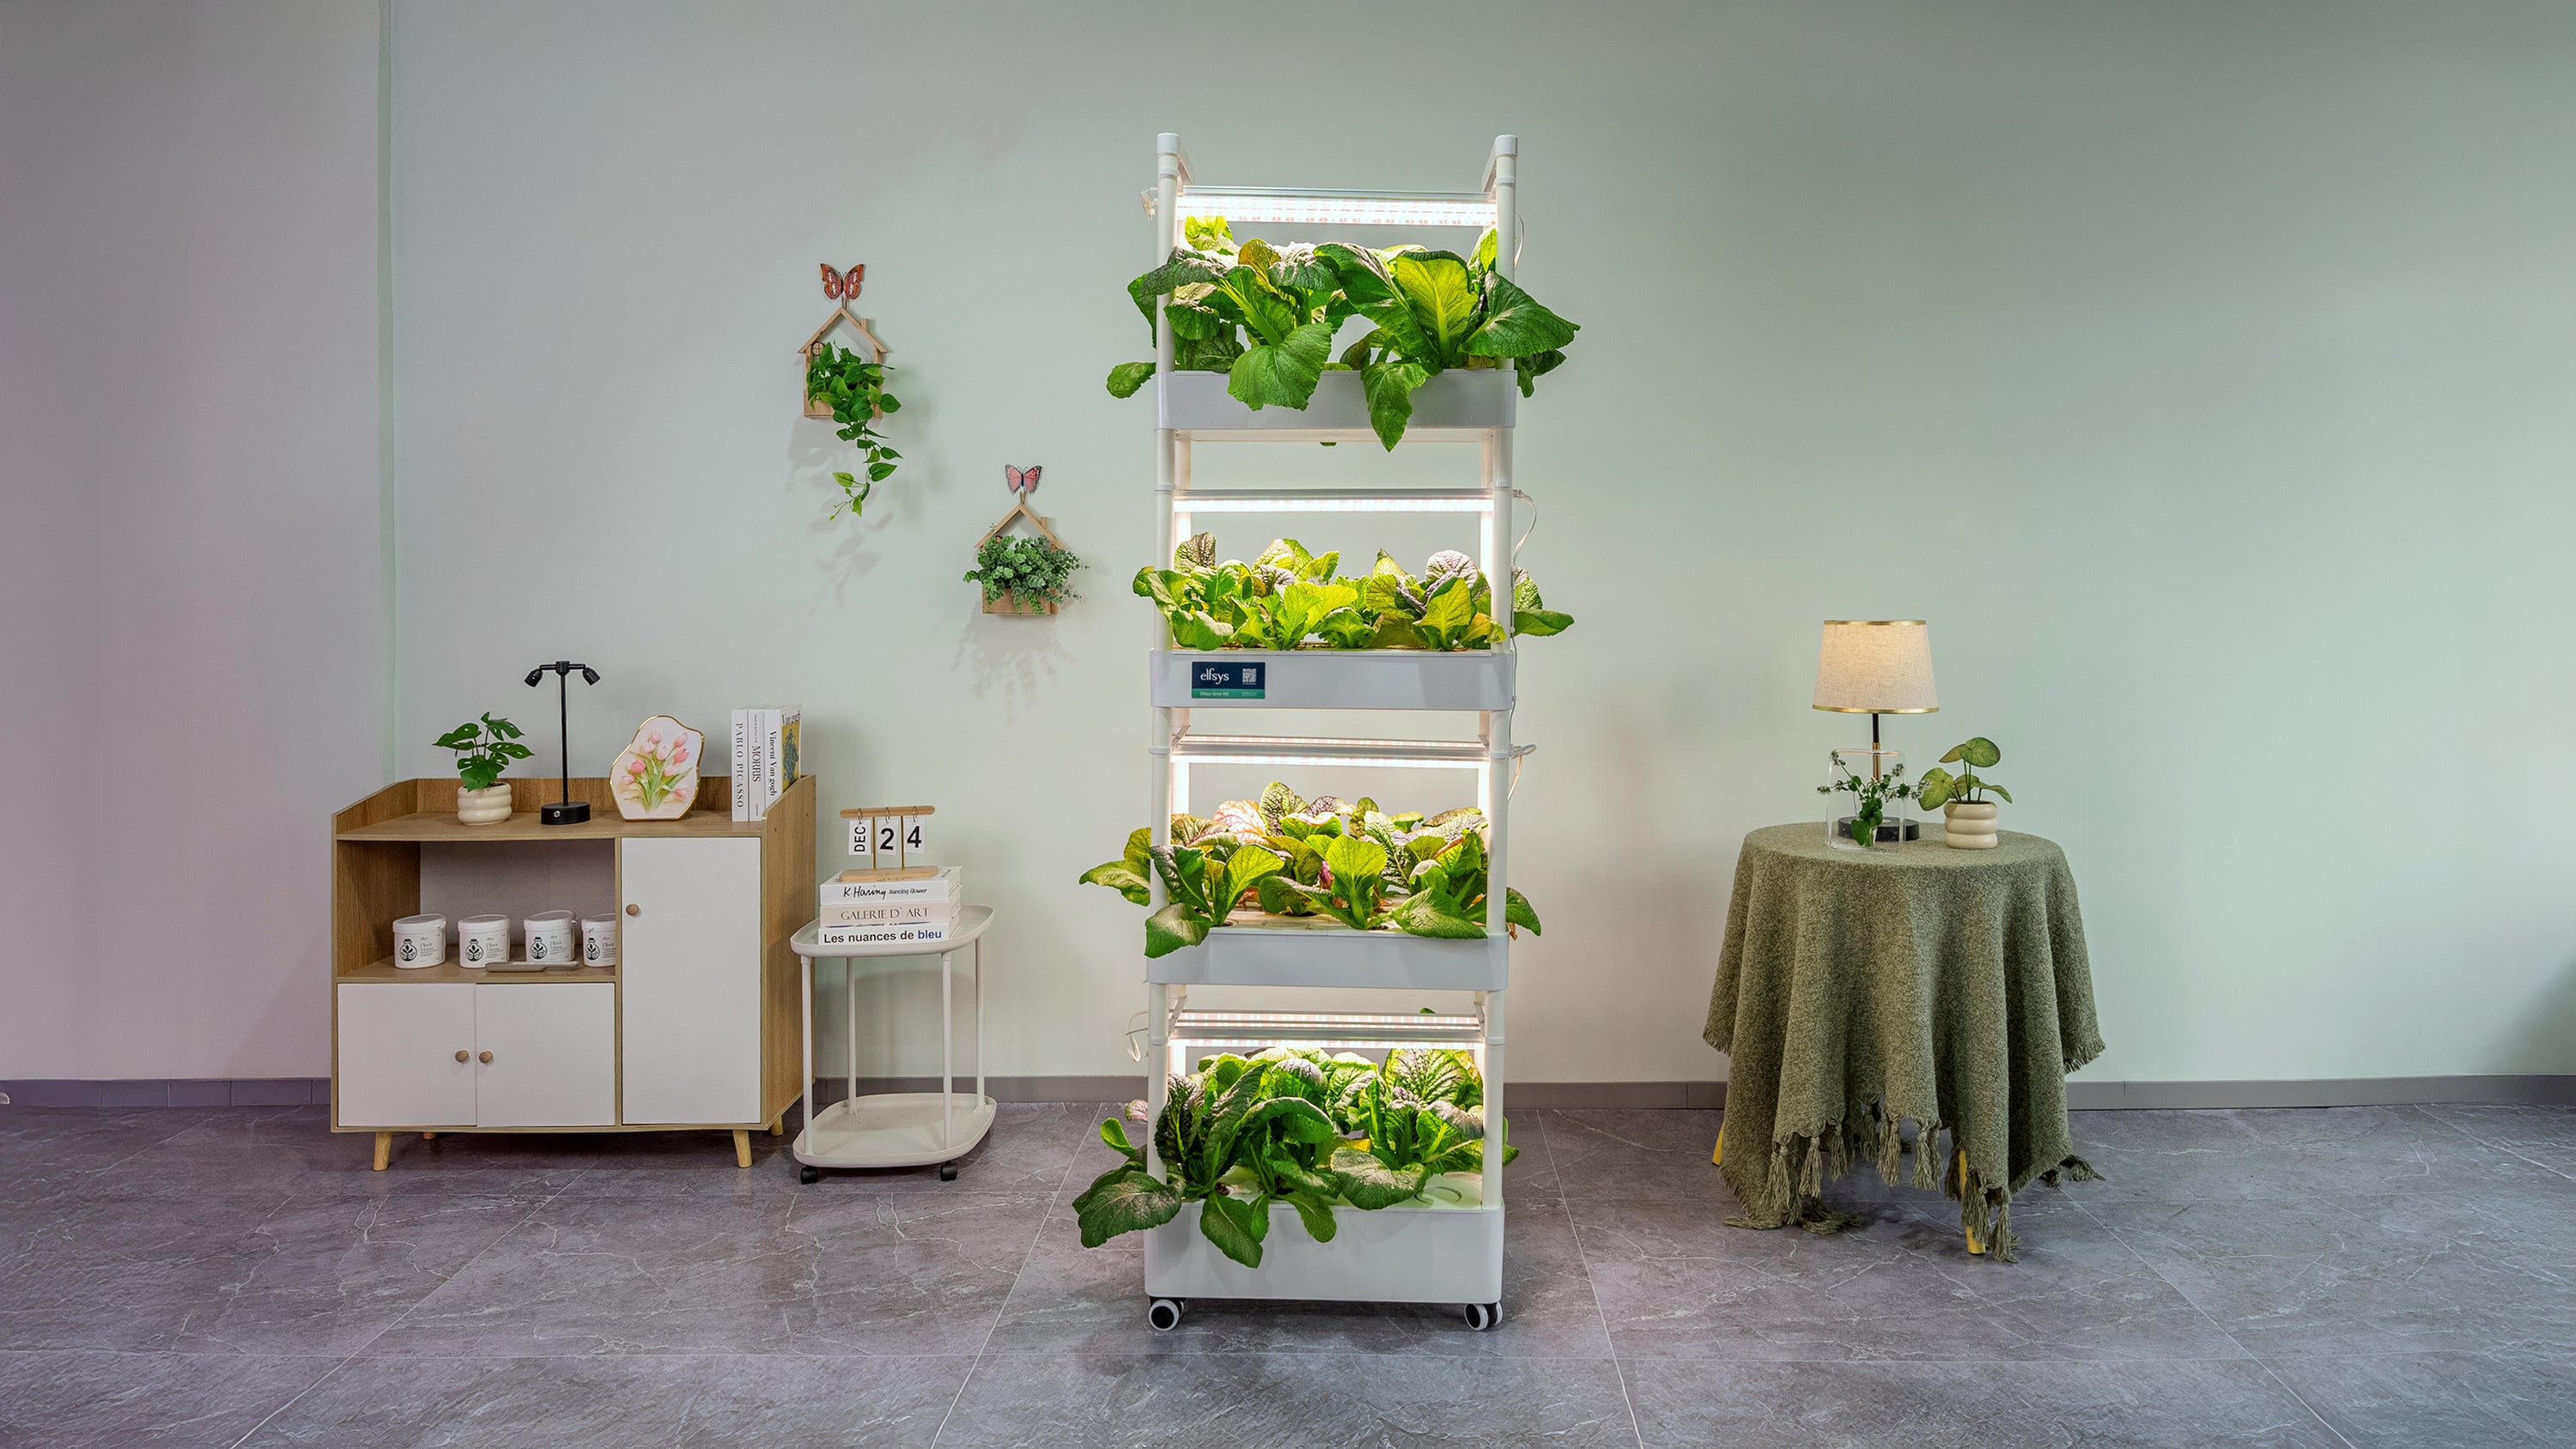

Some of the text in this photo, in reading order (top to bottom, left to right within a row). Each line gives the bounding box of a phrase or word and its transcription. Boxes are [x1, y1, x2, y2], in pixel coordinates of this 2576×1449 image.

[1200, 668, 1230, 685] elfsys
[769, 731, 777, 760] Vincent
[751, 746, 762, 782] MORRIS
[736, 763, 744, 809] PICASSO
[769, 778, 777, 797] gogh
[854, 825, 922, 852] DEC 2 4
[841, 909, 888, 921] GALERIE
[906, 907, 930, 918] ART
[823, 930, 943, 944] Les nuances de bleu
